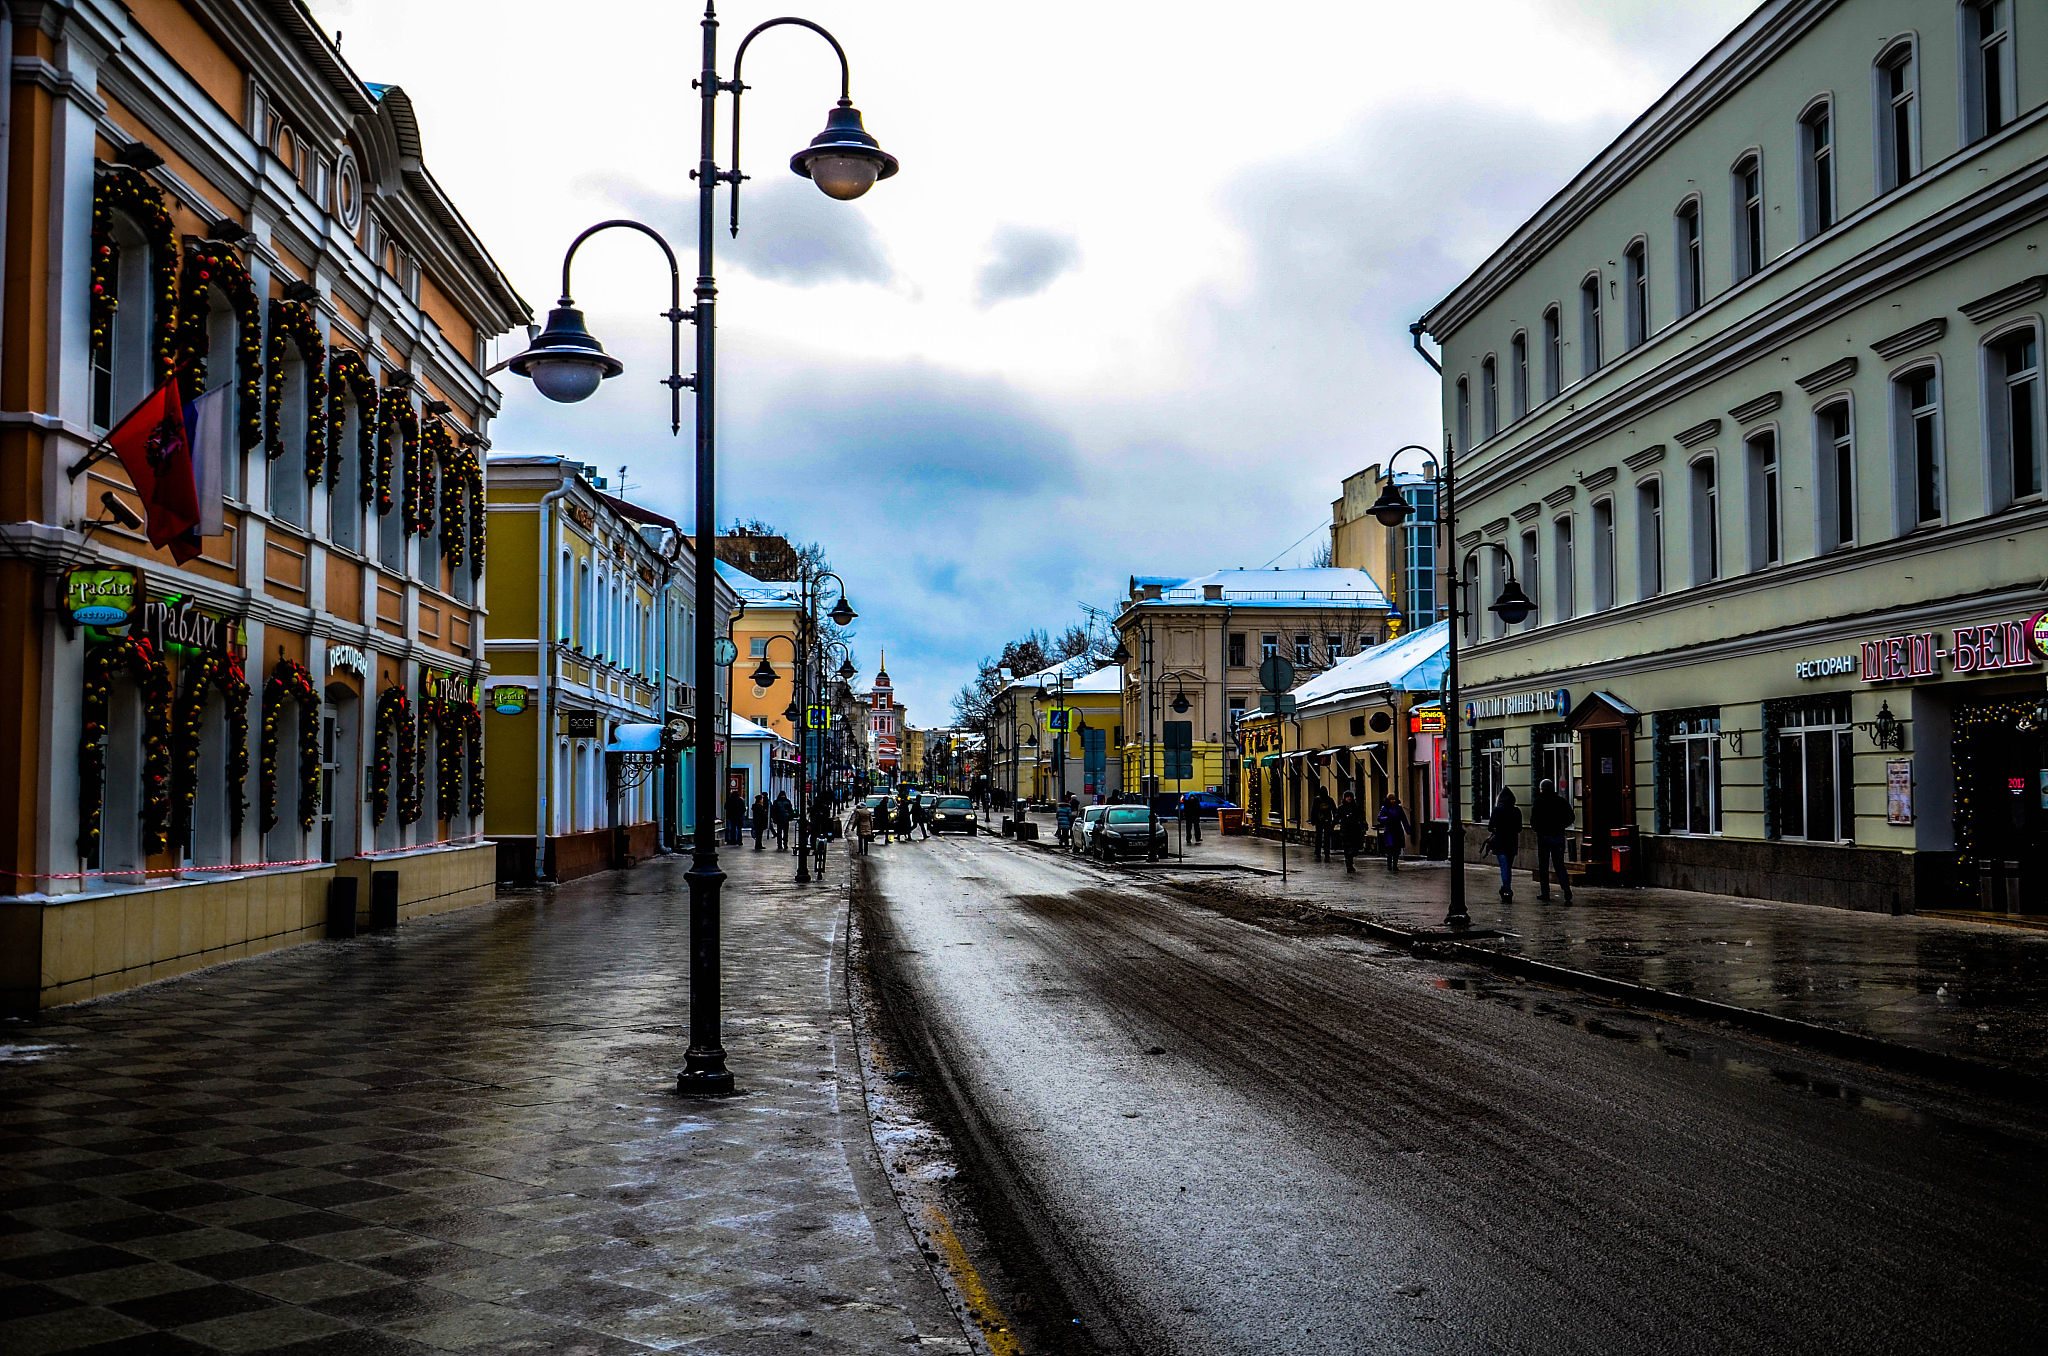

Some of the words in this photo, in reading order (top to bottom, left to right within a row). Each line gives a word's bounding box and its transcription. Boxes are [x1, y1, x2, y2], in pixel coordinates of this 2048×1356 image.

[69, 576, 132, 603] грабли
[74, 612, 126, 621] ресторан
[143, 598, 218, 652] грабли
[330, 645, 368, 678] ресторан
[1796, 655, 1851, 679] РЕСТОРАН
[440, 673, 469, 703] грабли
[1502, 693, 1535, 716] ГВИННЗ
[1536, 690, 1555, 711] ПАБ
[570, 718, 594, 727] ЭССЕ
